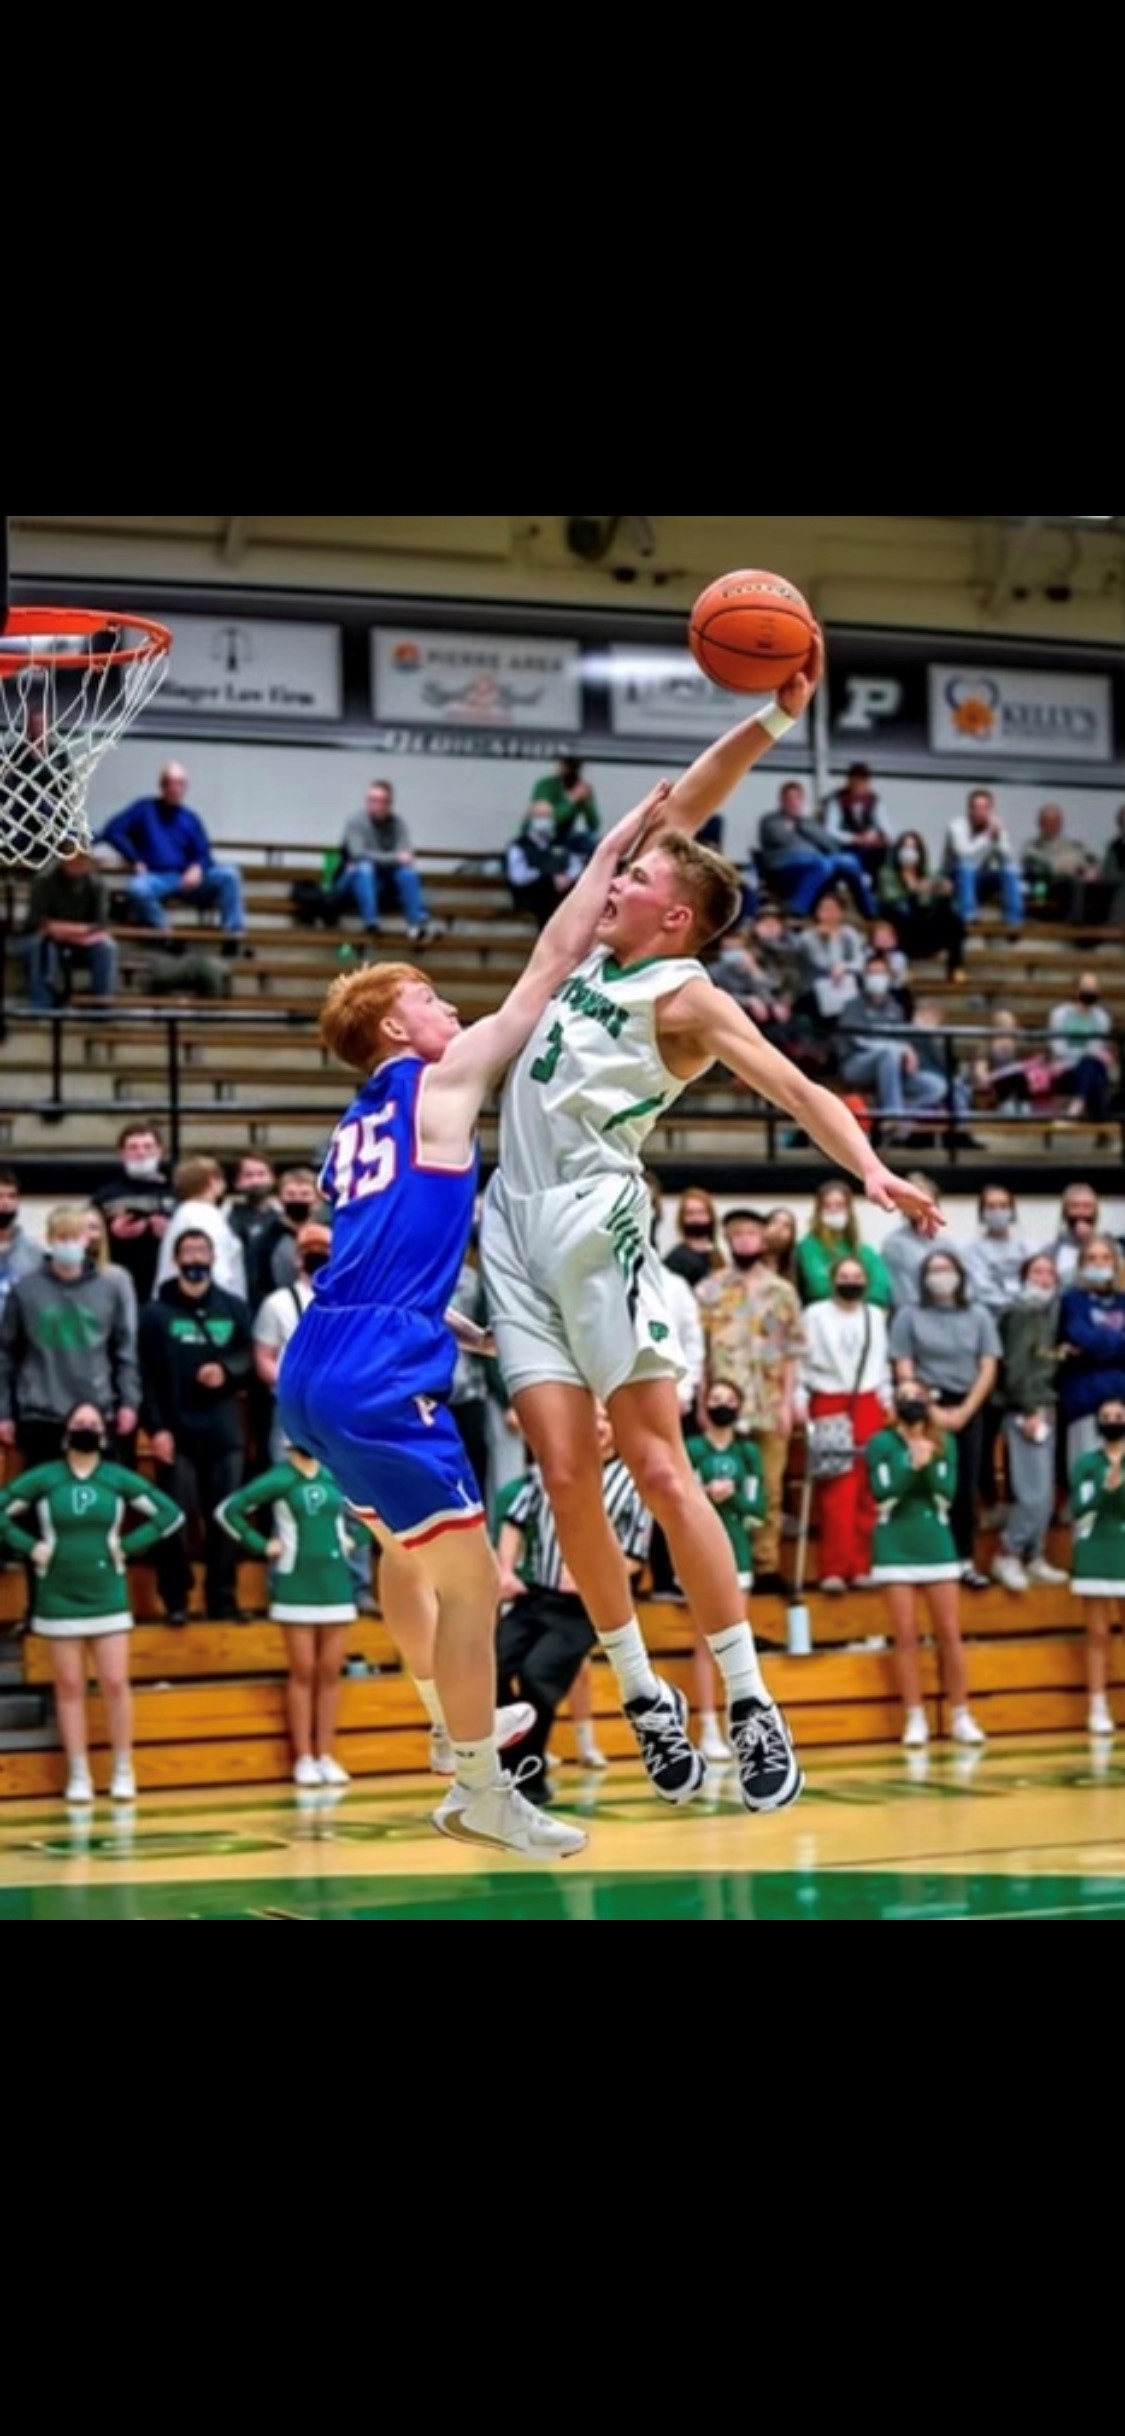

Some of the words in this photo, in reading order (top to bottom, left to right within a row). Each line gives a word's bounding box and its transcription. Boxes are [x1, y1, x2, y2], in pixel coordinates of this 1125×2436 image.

[838, 678, 902, 729] P
[1002, 702, 1098, 733] KELLY'S
[331, 1099, 398, 1210] 15
[71, 1484, 98, 1515] P
[302, 1483, 329, 1516] P
